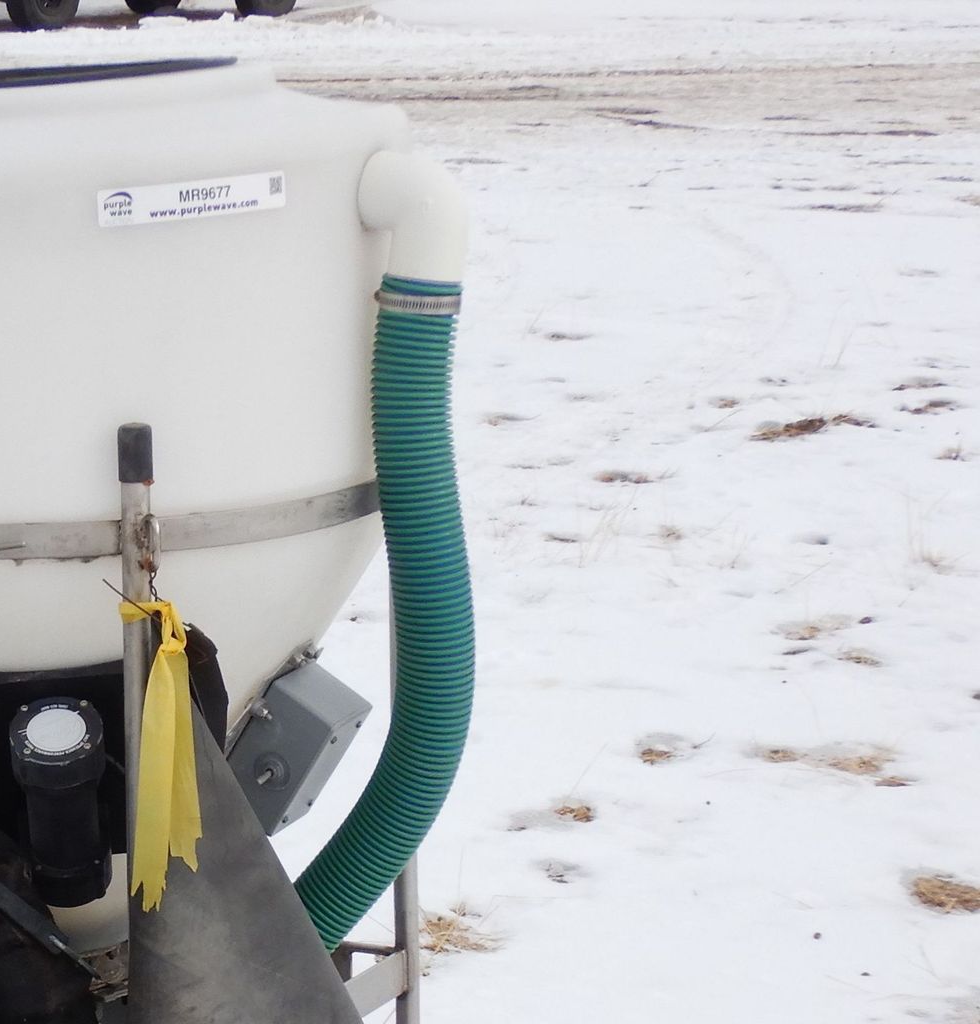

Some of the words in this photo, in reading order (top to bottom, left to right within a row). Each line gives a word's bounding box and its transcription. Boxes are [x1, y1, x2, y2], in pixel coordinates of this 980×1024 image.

[178, 185, 232, 203] MR9677
[103, 200, 133, 211] purple
[109, 208, 133, 217] wave
[149, 199, 259, 218] www.purplewave.com
